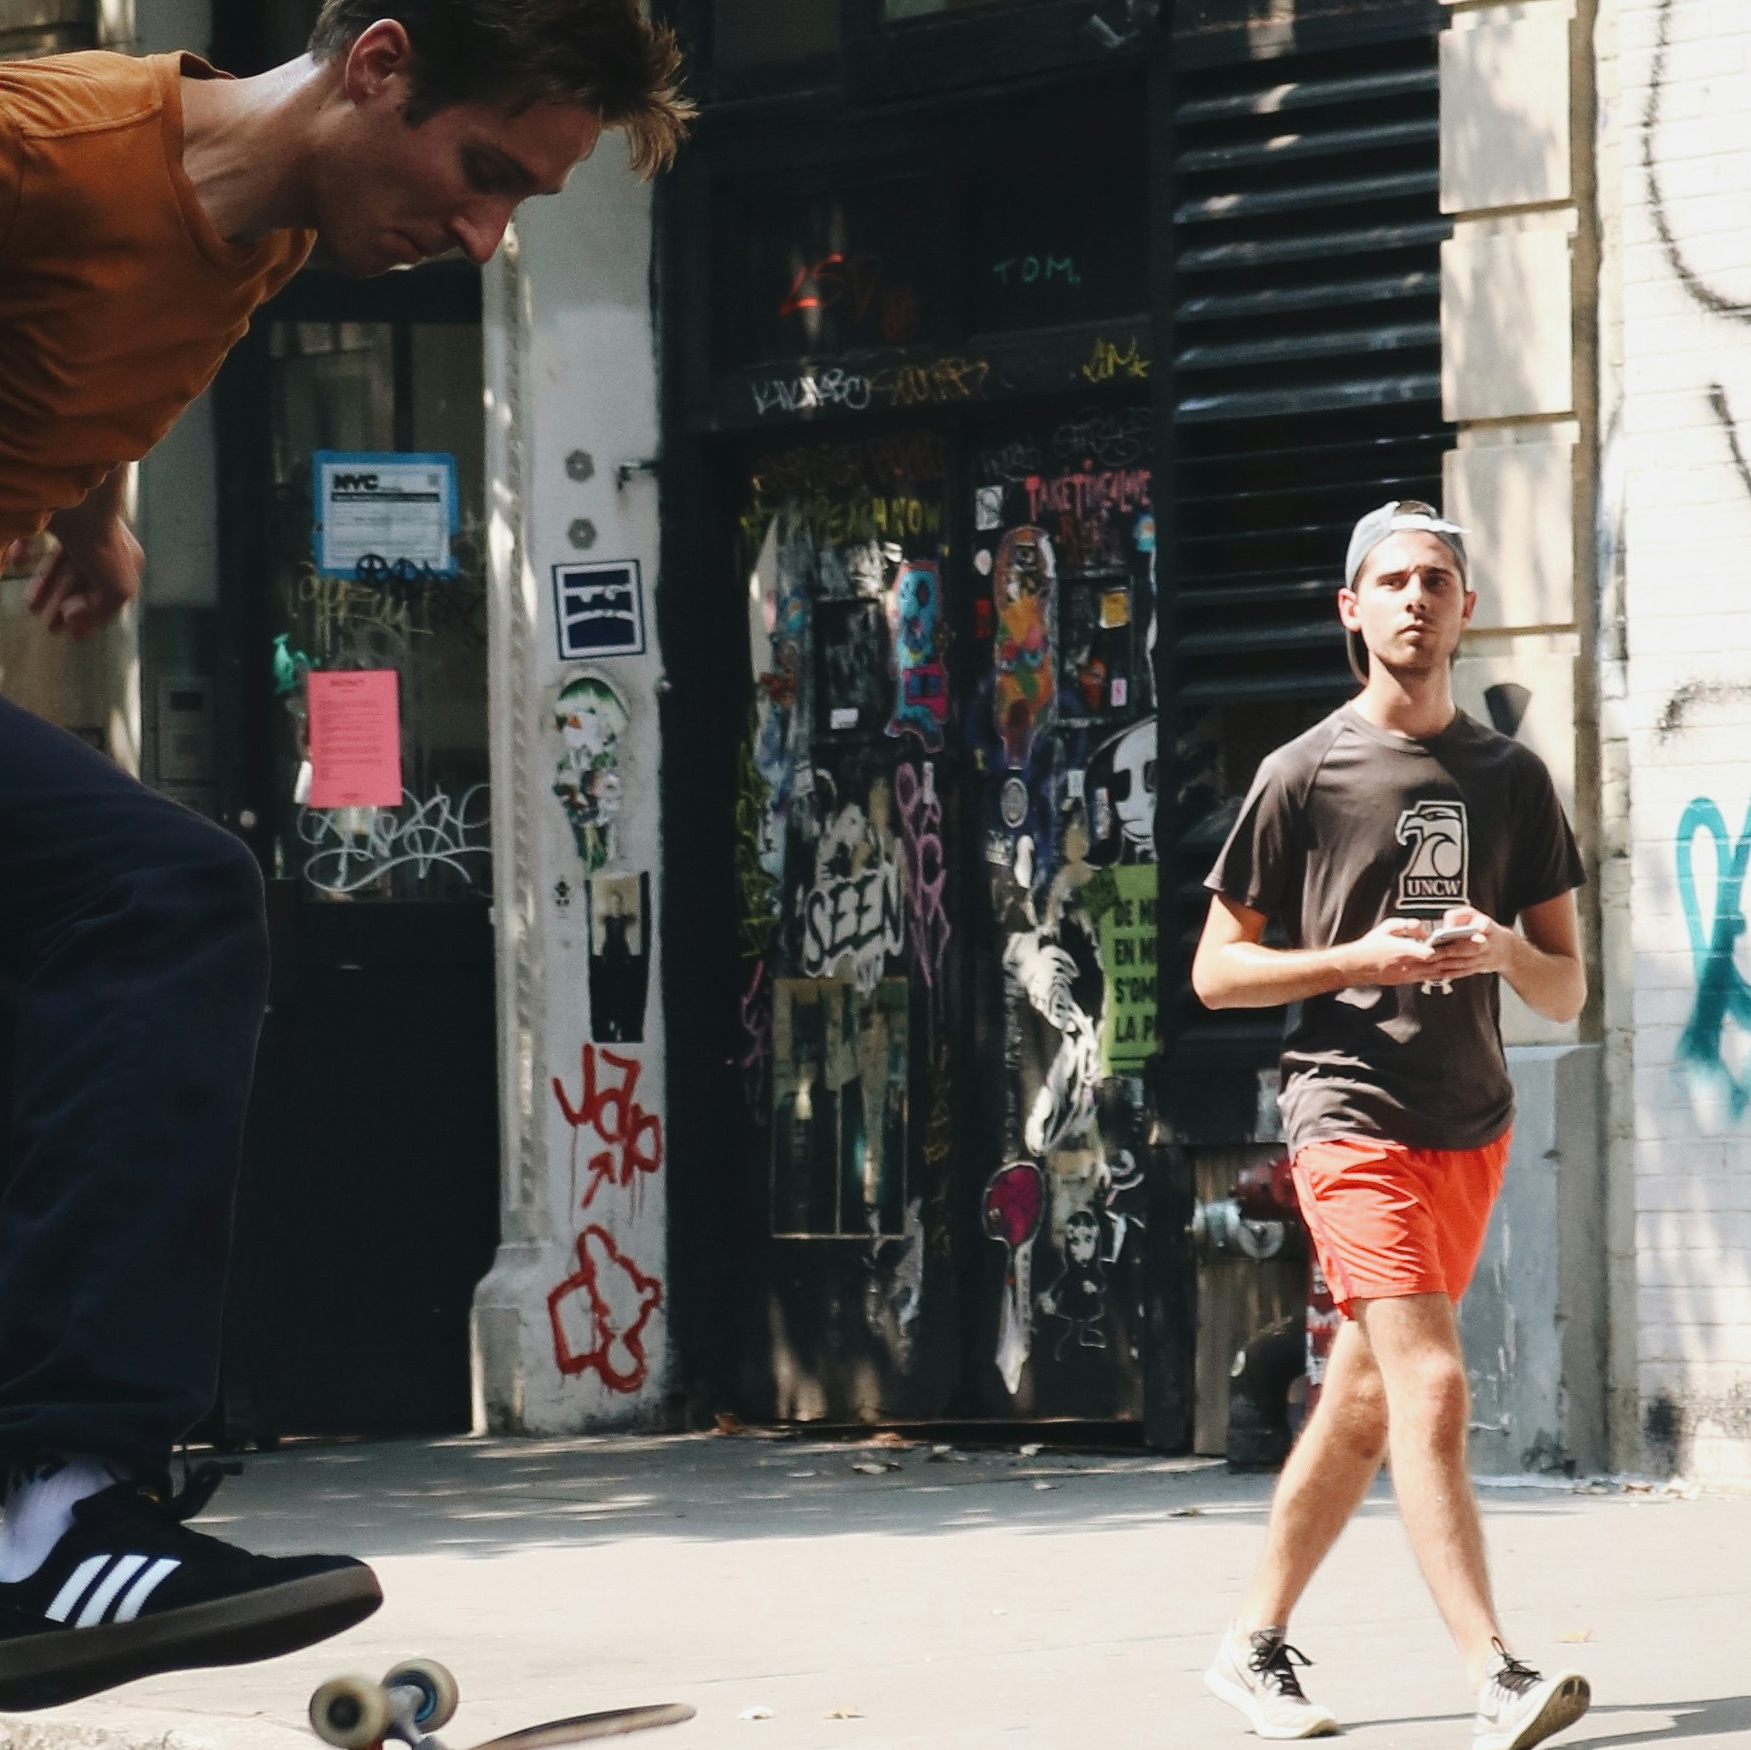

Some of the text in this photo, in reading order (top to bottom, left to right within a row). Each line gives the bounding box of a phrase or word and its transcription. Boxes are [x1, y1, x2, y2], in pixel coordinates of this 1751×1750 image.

[333, 473, 378, 490] NYC
[1407, 879, 1462, 896] UNCW
[805, 868, 904, 975] SEEN
